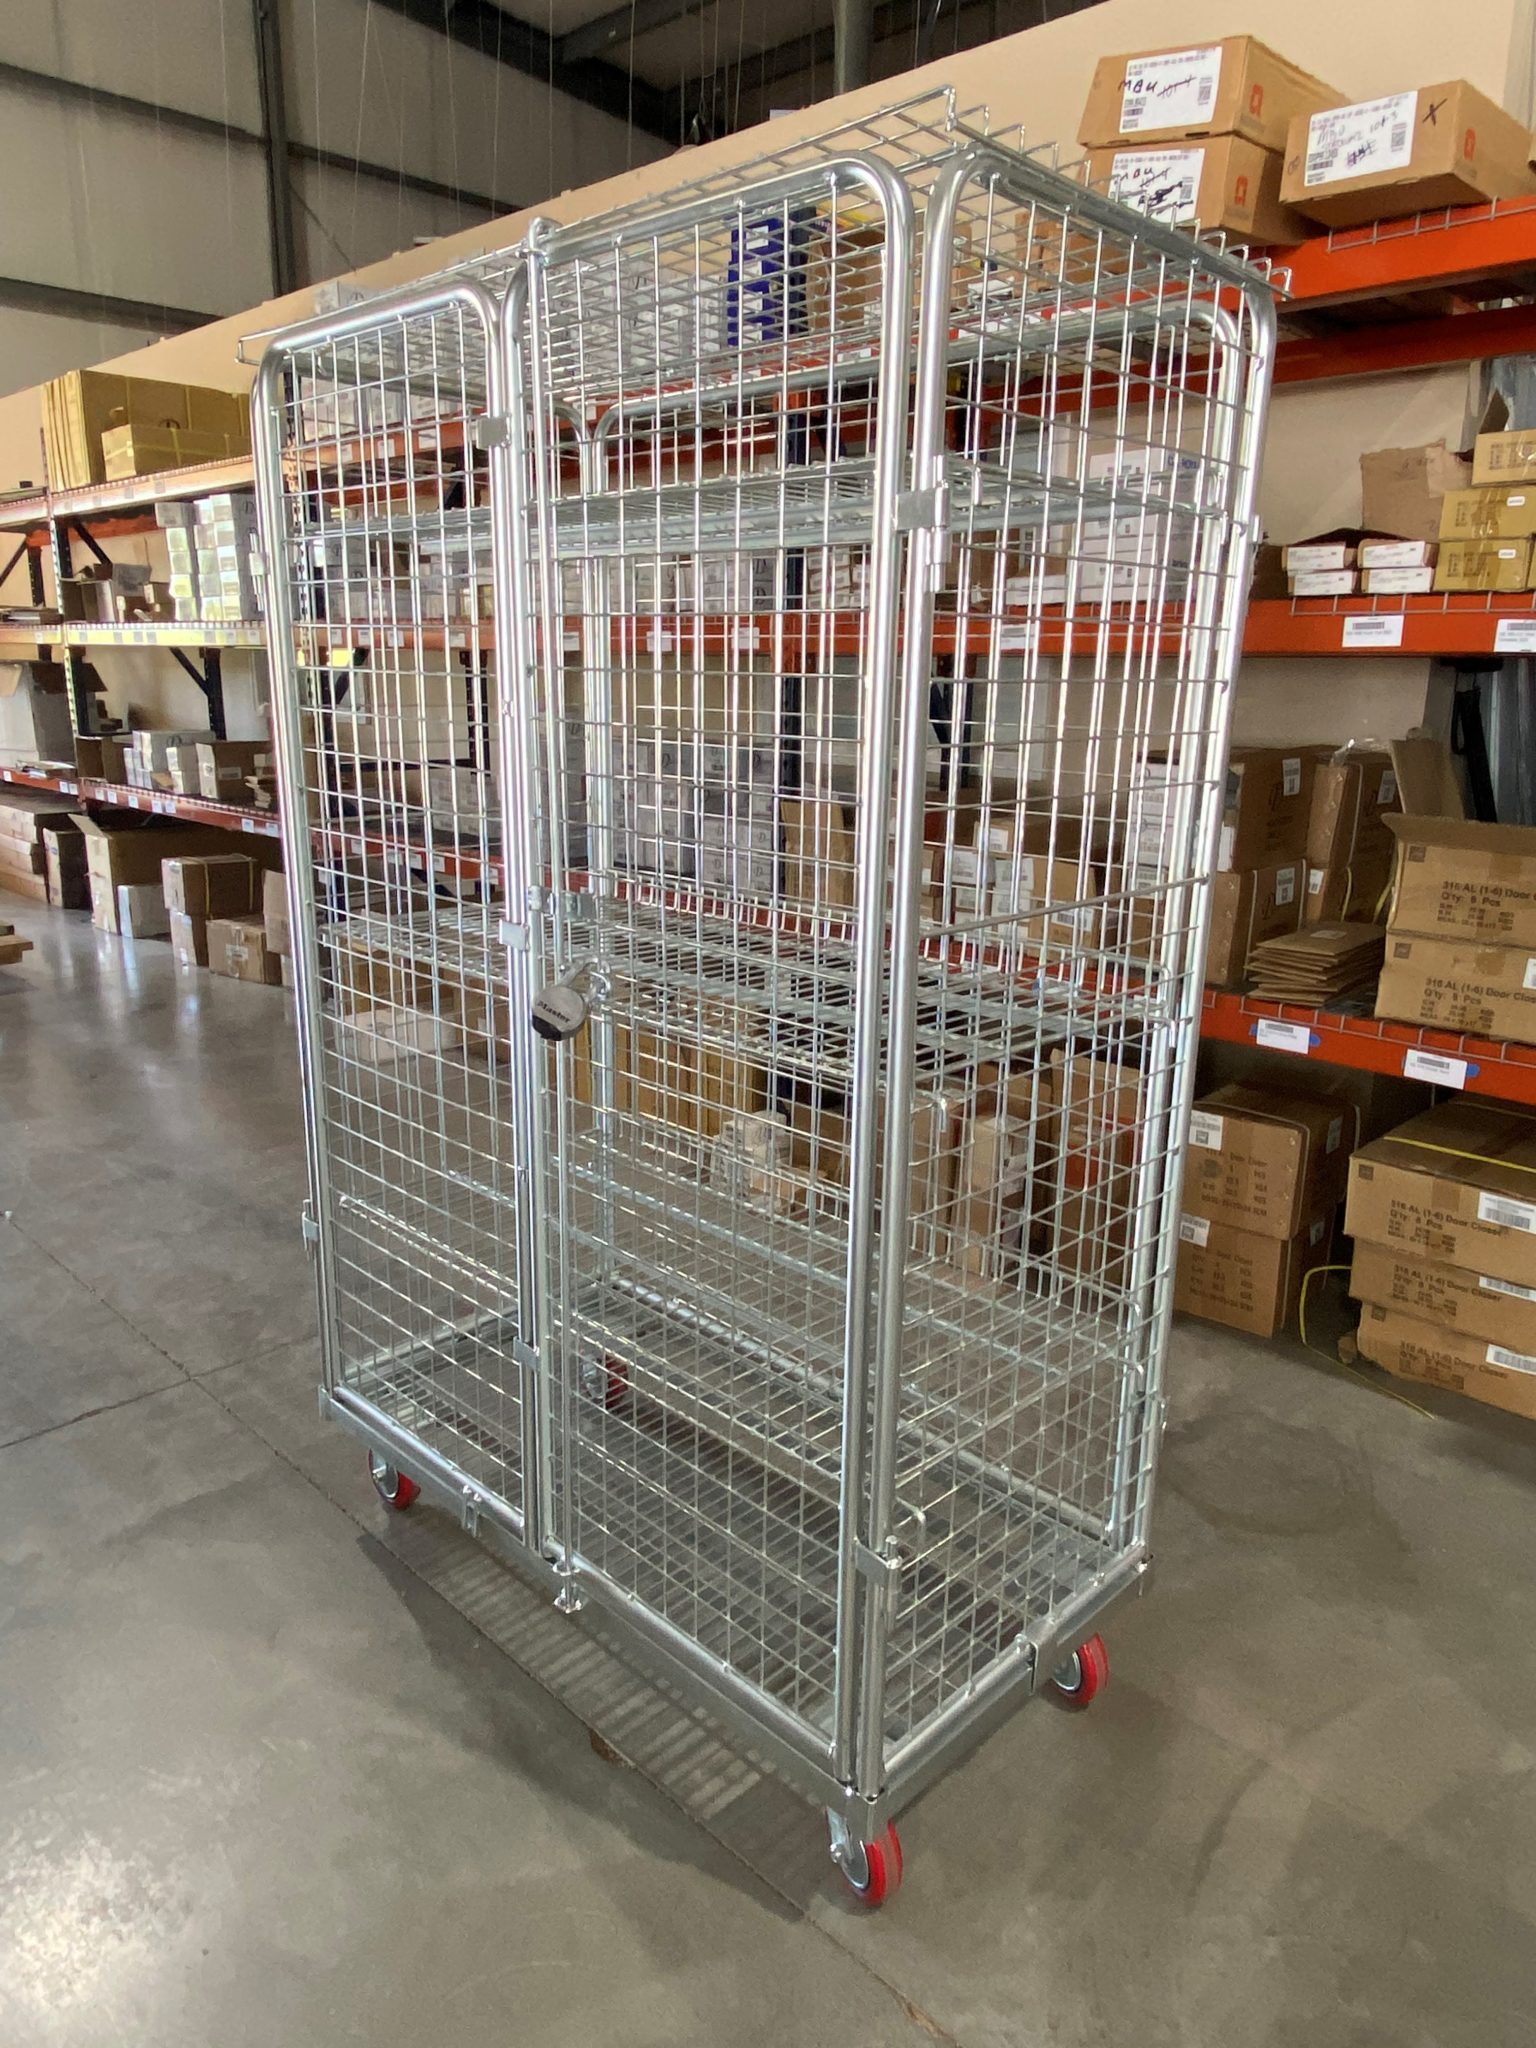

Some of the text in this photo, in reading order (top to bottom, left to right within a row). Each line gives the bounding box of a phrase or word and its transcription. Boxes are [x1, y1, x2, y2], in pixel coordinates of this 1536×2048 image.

[1463, 883, 1476, 893] AL
[1505, 888, 1531, 899] Door
[1425, 978, 1443, 987] 316
[1444, 981, 1457, 990] AL
[1461, 982, 1484, 995] (1-6)
[1486, 987, 1510, 999] Door
[1463, 994, 1482, 1005] Pcs
[537, 1000, 571, 1023] Master
[1446, 1214, 1468, 1227] Door
